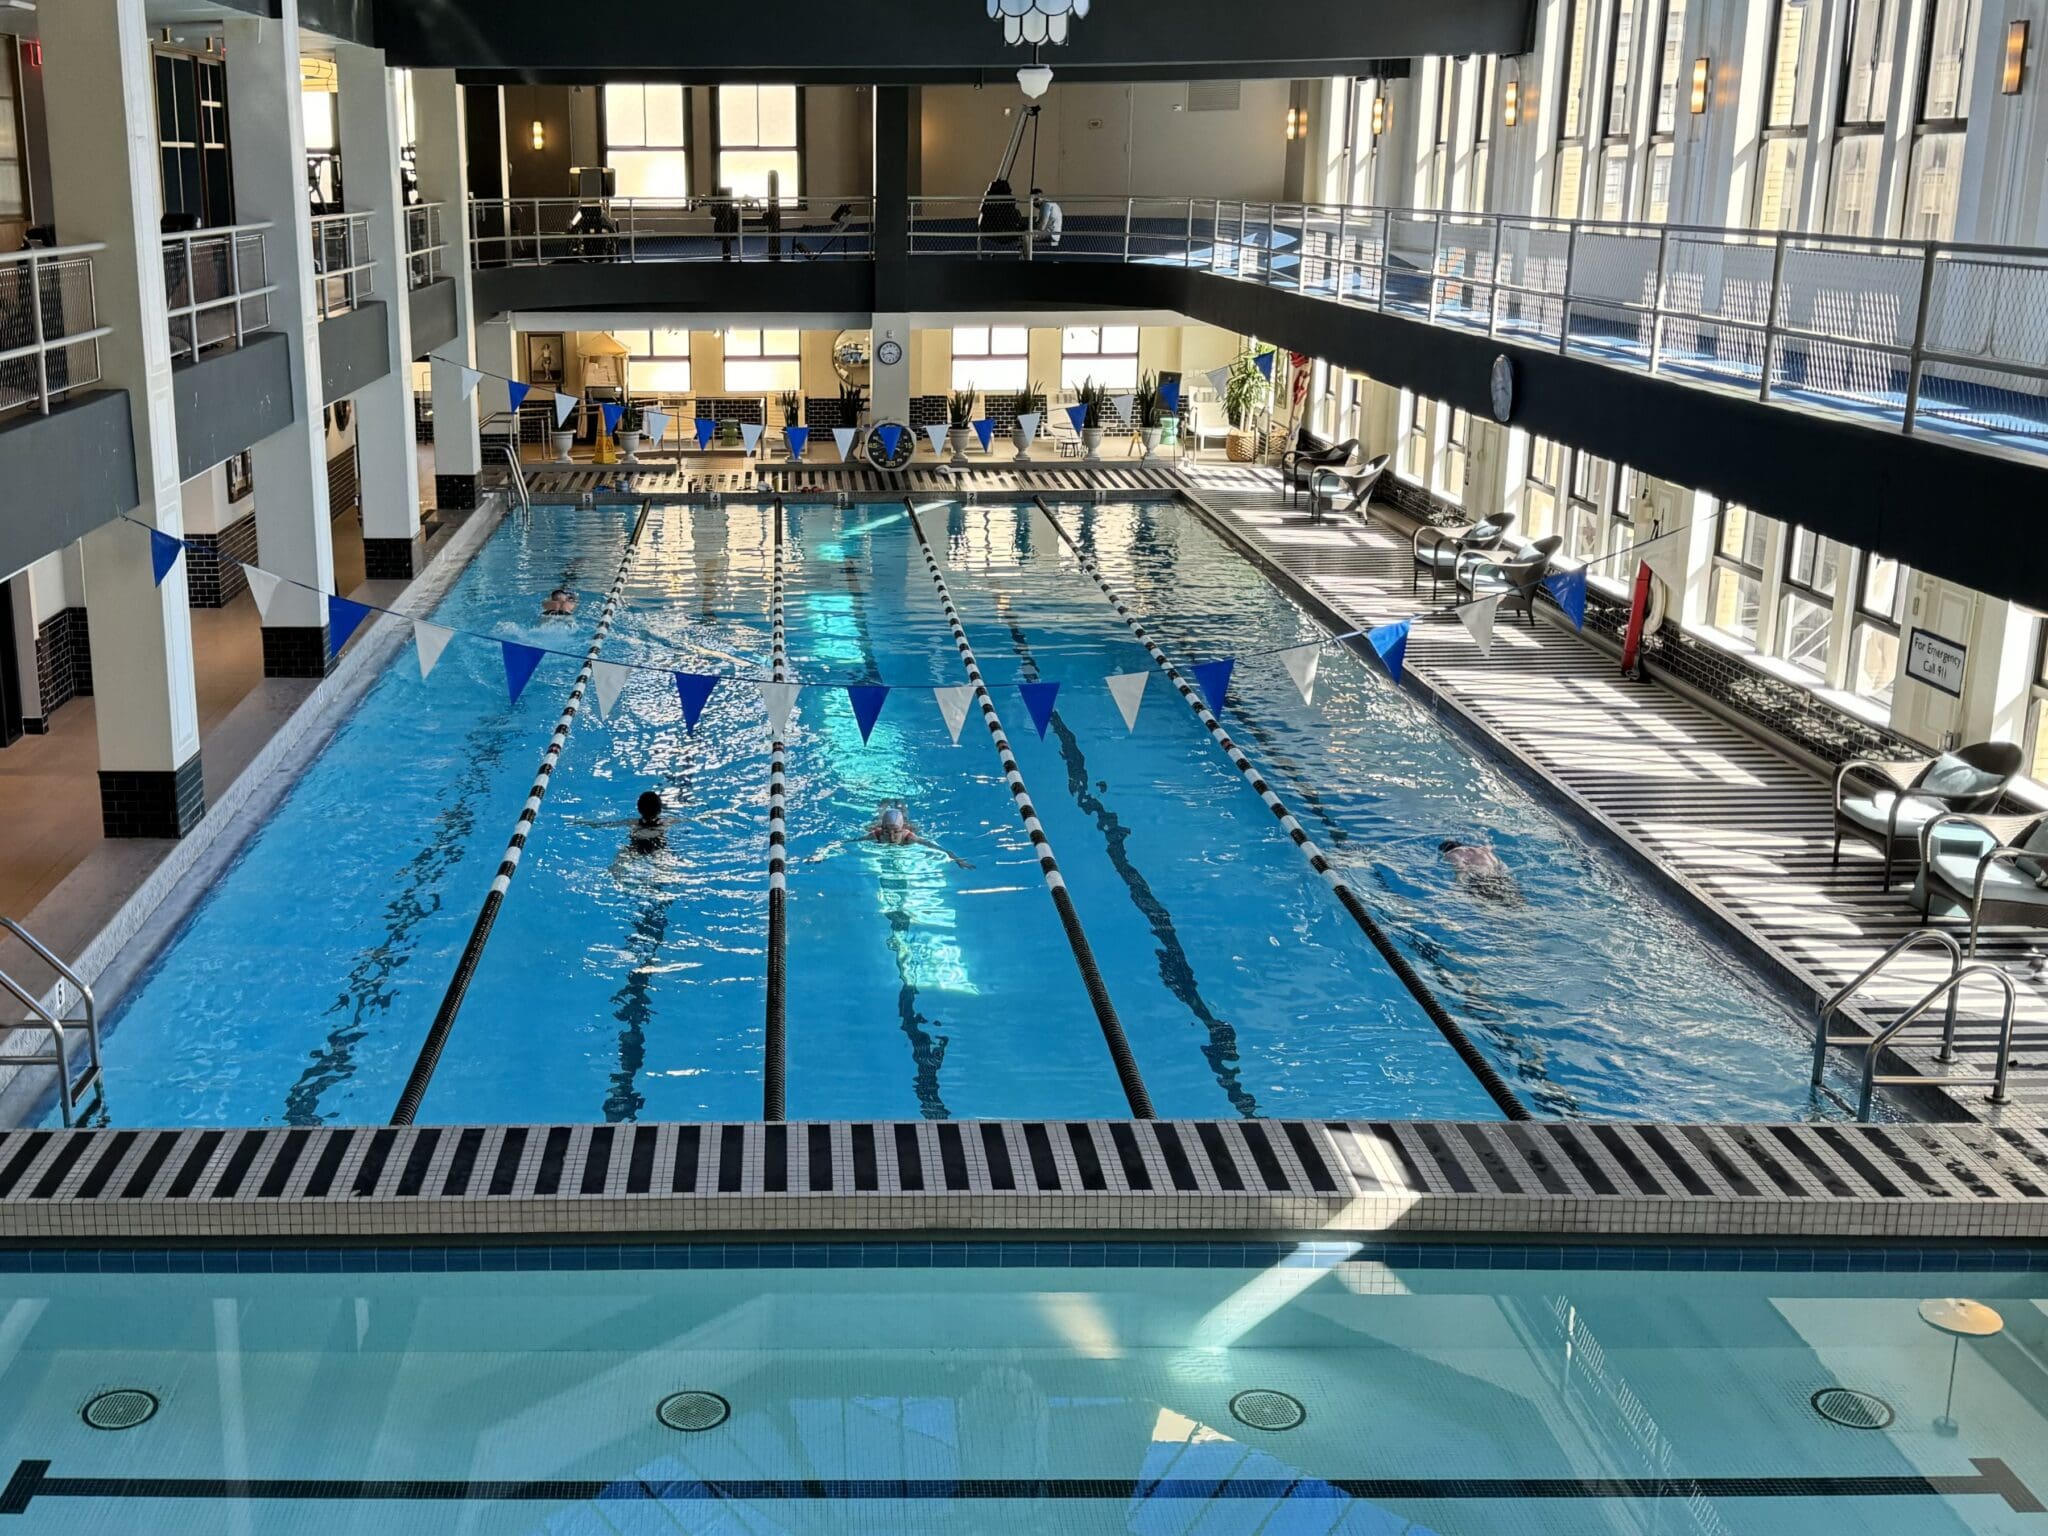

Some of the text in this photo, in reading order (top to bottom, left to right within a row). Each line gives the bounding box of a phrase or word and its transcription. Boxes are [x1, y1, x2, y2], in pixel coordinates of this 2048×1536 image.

[1914, 637, 1961, 669] For Emergency
[1923, 660, 1947, 679] Call 911
